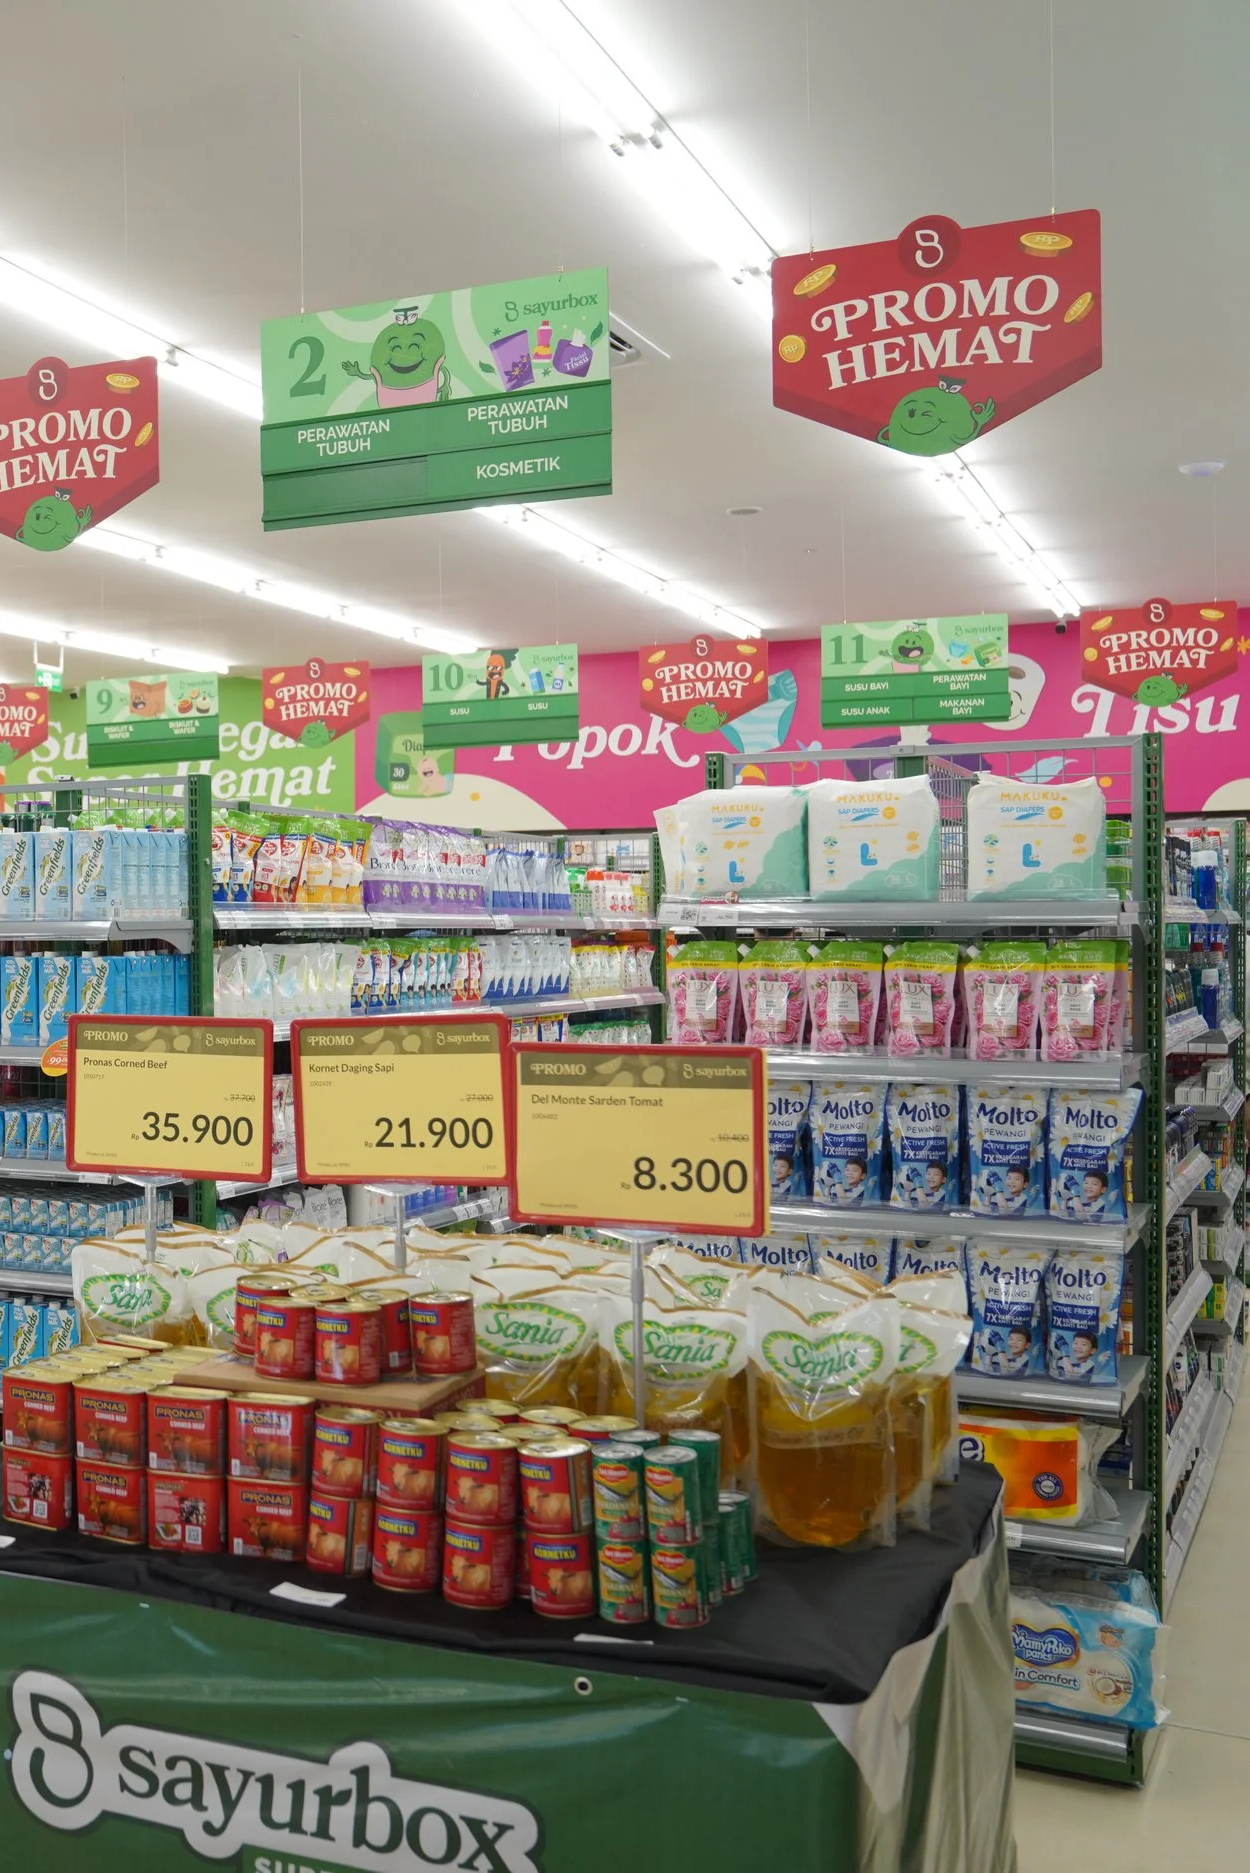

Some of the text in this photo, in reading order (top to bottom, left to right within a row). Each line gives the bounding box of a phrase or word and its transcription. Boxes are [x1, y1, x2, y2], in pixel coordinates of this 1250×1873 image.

[523, 294, 598, 316] sayurbox
[810, 274, 1059, 341] PROMO
[822, 321, 1051, 390] HEMAT
[288, 336, 327, 398] 2
[564, 356, 590, 371] Tissu
[467, 396, 569, 423] PERAWATAN
[487, 411, 548, 435] TUBUH
[297, 418, 390, 445] PERAWATAN
[316, 434, 372, 457] TUBUH
[476, 455, 560, 480] KOSMETIK
[964, 624, 1004, 635] sayurbox
[1100, 627, 1218, 652] PROMO
[829, 633, 870, 666] 11
[1106, 648, 1214, 676] HEMAT
[429, 662, 464, 692] 10
[654, 661, 752, 684] PROMO
[932, 673, 987, 685] PERAWATAN
[276, 683, 357, 702] PROMO
[659, 680, 748, 703] HEMAT
[845, 681, 889, 692] SUSU BAYI
[950, 681, 970, 691] BAYI
[96, 689, 113, 714] 9
[528, 701, 548, 711] SUSU
[939, 698, 985, 709] MAKANAN
[280, 700, 354, 721] HEMAT
[450, 706, 470, 716] SUSU
[841, 706, 890, 717] SUSU ANAK
[952, 706, 972, 716] BAYI
[1072, 684, 1240, 737] Tisu
[104, 725, 127, 734] BISKUIT
[169, 721, 192, 730] BISKUIT
[173, 727, 196, 735] WAFER
[108, 732, 130, 740] WAFER
[393, 768, 405, 778] 30
[838, 793, 892, 803] MAKUKU
[1001, 792, 1060, 801] MAKUKU
[4, 963, 30, 1018] Greenfields
[84, 1031, 128, 1042] PROMO
[216, 1036, 256, 1046] sayurbox
[306, 1035, 354, 1046] PROMO
[447, 1033, 490, 1044] sayurbox
[84, 1057, 168, 1069] Pronas Corned Beef
[309, 1062, 394, 1074] Kornet Daging Sapi
[530, 1064, 586, 1076] PROMO
[696, 1066, 748, 1078] sayurbox
[532, 1094, 664, 1107] Del Monte Sarden Tomat
[977, 1102, 1038, 1126] Molto
[1066, 1106, 1118, 1128] Molto
[142, 1112, 253, 1146] 35.900
[374, 1117, 494, 1148] 21.900
[984, 1128, 1026, 1138] PEWANGI
[984, 1142, 1028, 1150] ACTIVE FRESH
[984, 1154, 995, 1164] 7X
[621, 1156, 748, 1194] Rp 8.300
[751, 1243, 808, 1266] Molto
[484, 1312, 566, 1348] Sania
[642, 1325, 718, 1363] Sania
[12, 1388, 54, 1402] PRONAS
[156, 1407, 204, 1420] PRONAS
[170, 1420, 206, 1430] CORNED BEEF
[384, 1441, 423, 1456] KORNETKU
[534, 1546, 575, 1560] KORNETKU
[1028, 1670, 1078, 1687] Comfort
[117, 1744, 516, 1873] sayurbox
